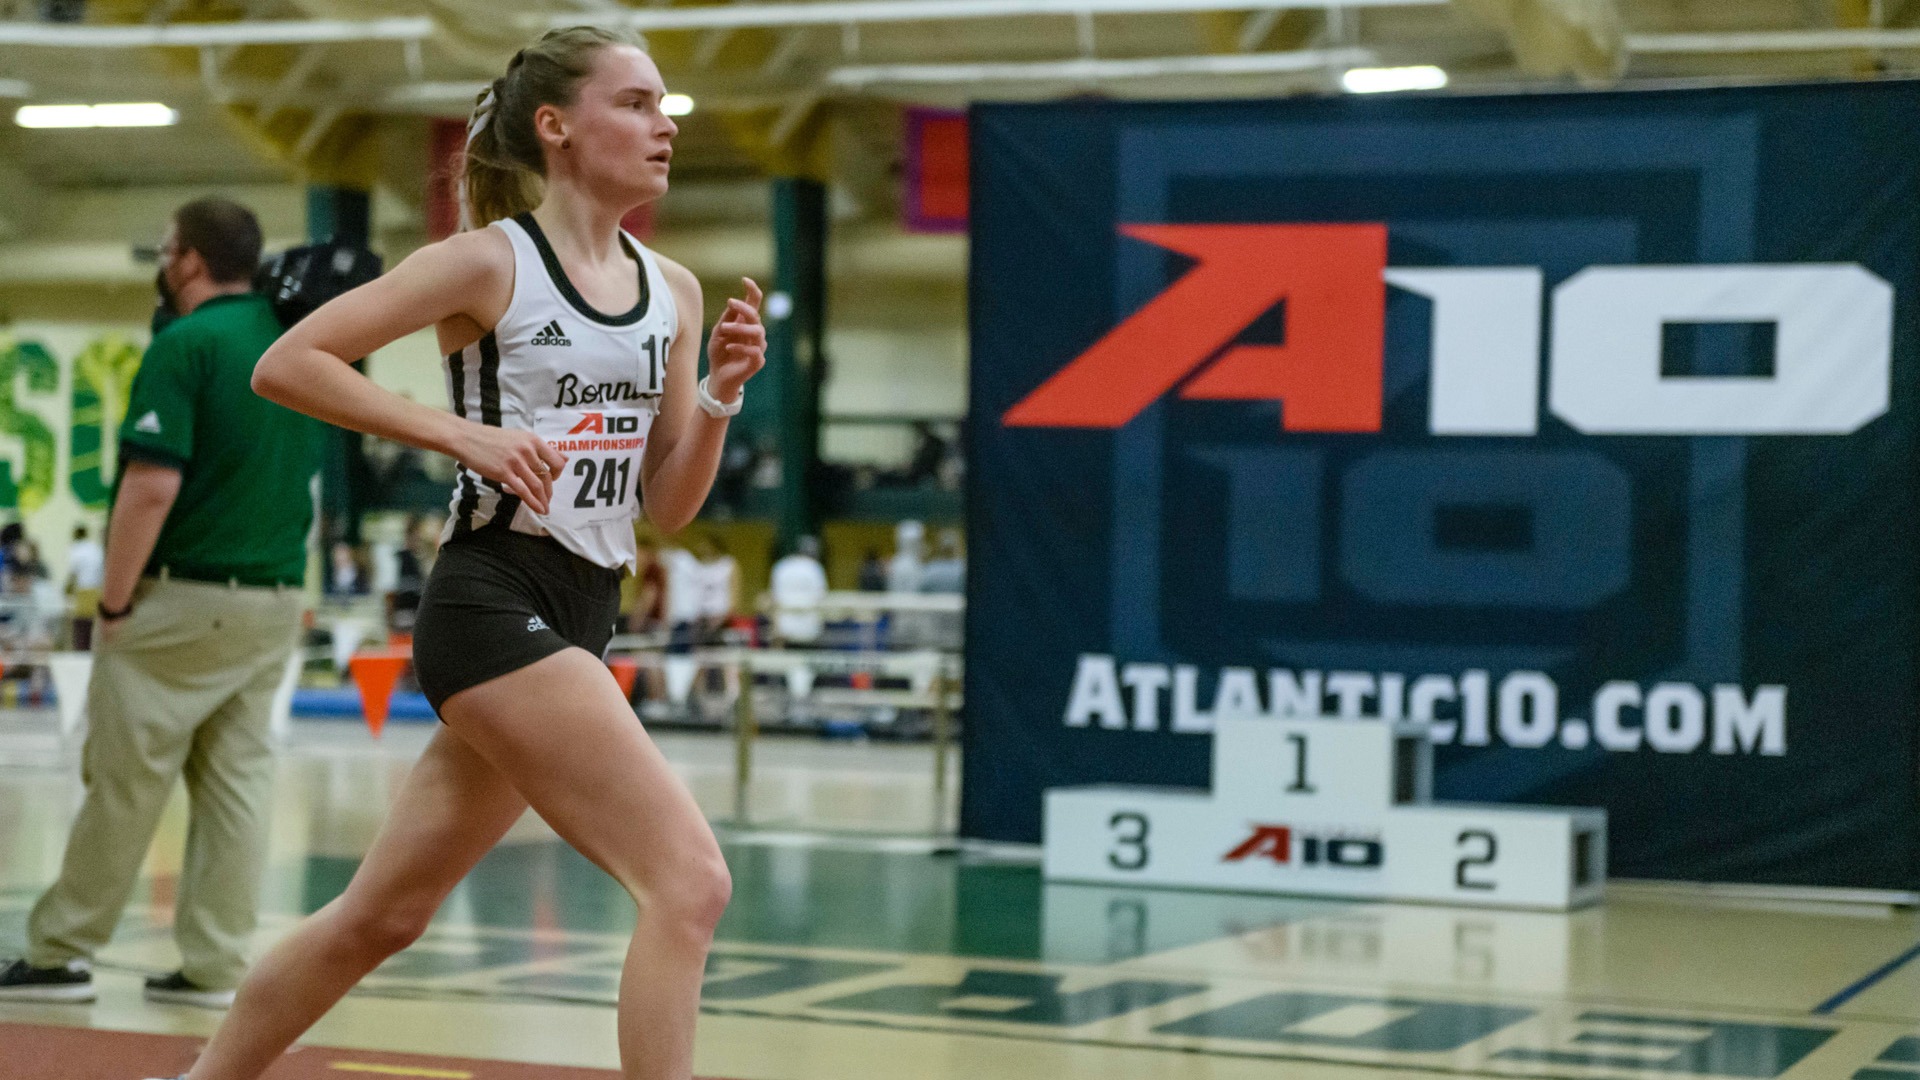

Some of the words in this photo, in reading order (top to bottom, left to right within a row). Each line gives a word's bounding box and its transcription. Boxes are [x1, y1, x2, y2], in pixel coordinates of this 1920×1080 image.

[531, 336, 572, 346] adidas
[1001, 223, 1895, 436] A10
[547, 437, 645, 452] CHAMPIONSHIPS
[567, 412, 638, 435] A10
[574, 457, 631, 508] 241
[1284, 733, 1319, 794] 1
[1108, 812, 1150, 870] 3
[1223, 825, 1384, 868] A10
[1455, 829, 1497, 890] 2
